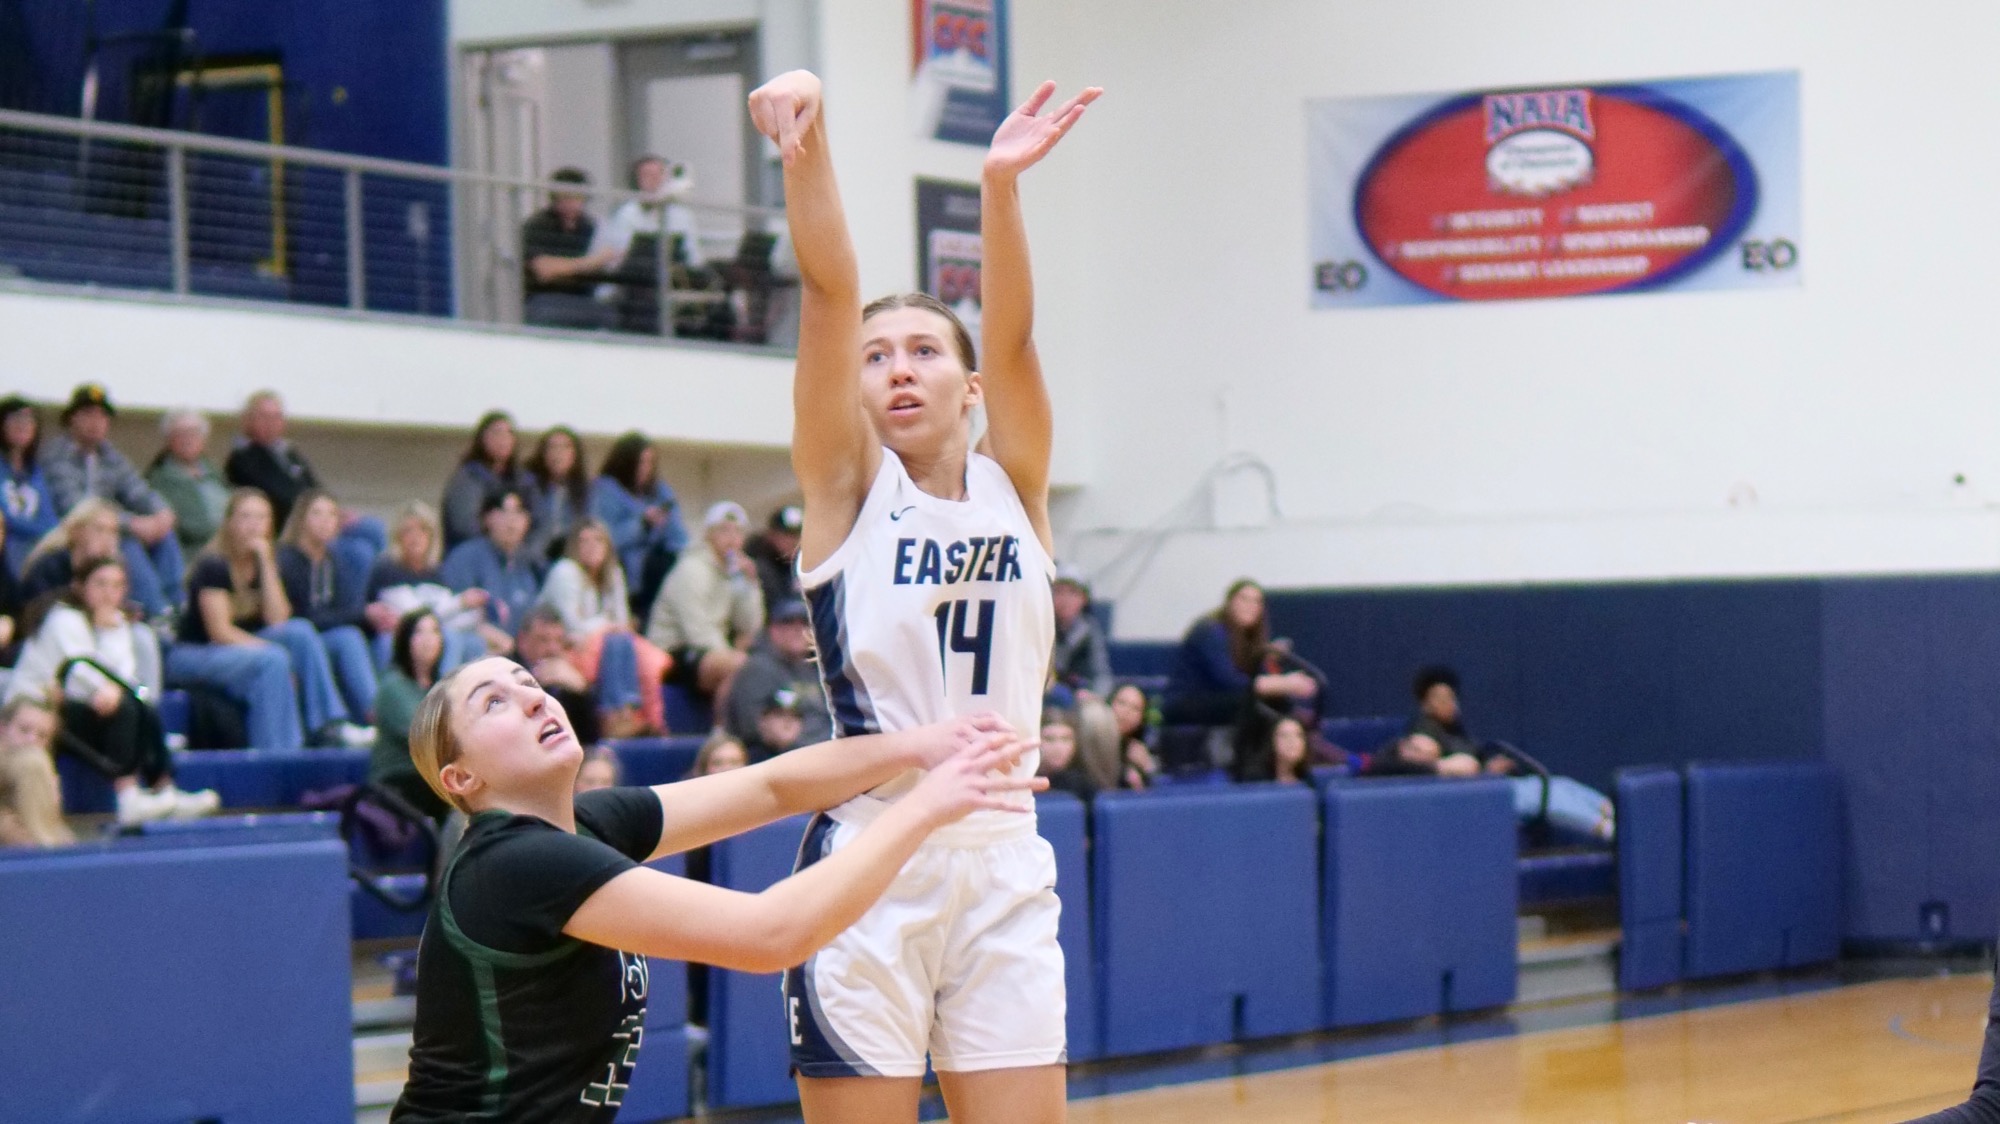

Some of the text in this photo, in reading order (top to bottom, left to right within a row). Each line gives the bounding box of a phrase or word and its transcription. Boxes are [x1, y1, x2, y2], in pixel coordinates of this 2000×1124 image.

[1486, 90, 1594, 140] NAIA
[893, 534, 1022, 585] EASTER
[934, 599, 996, 697] 14
